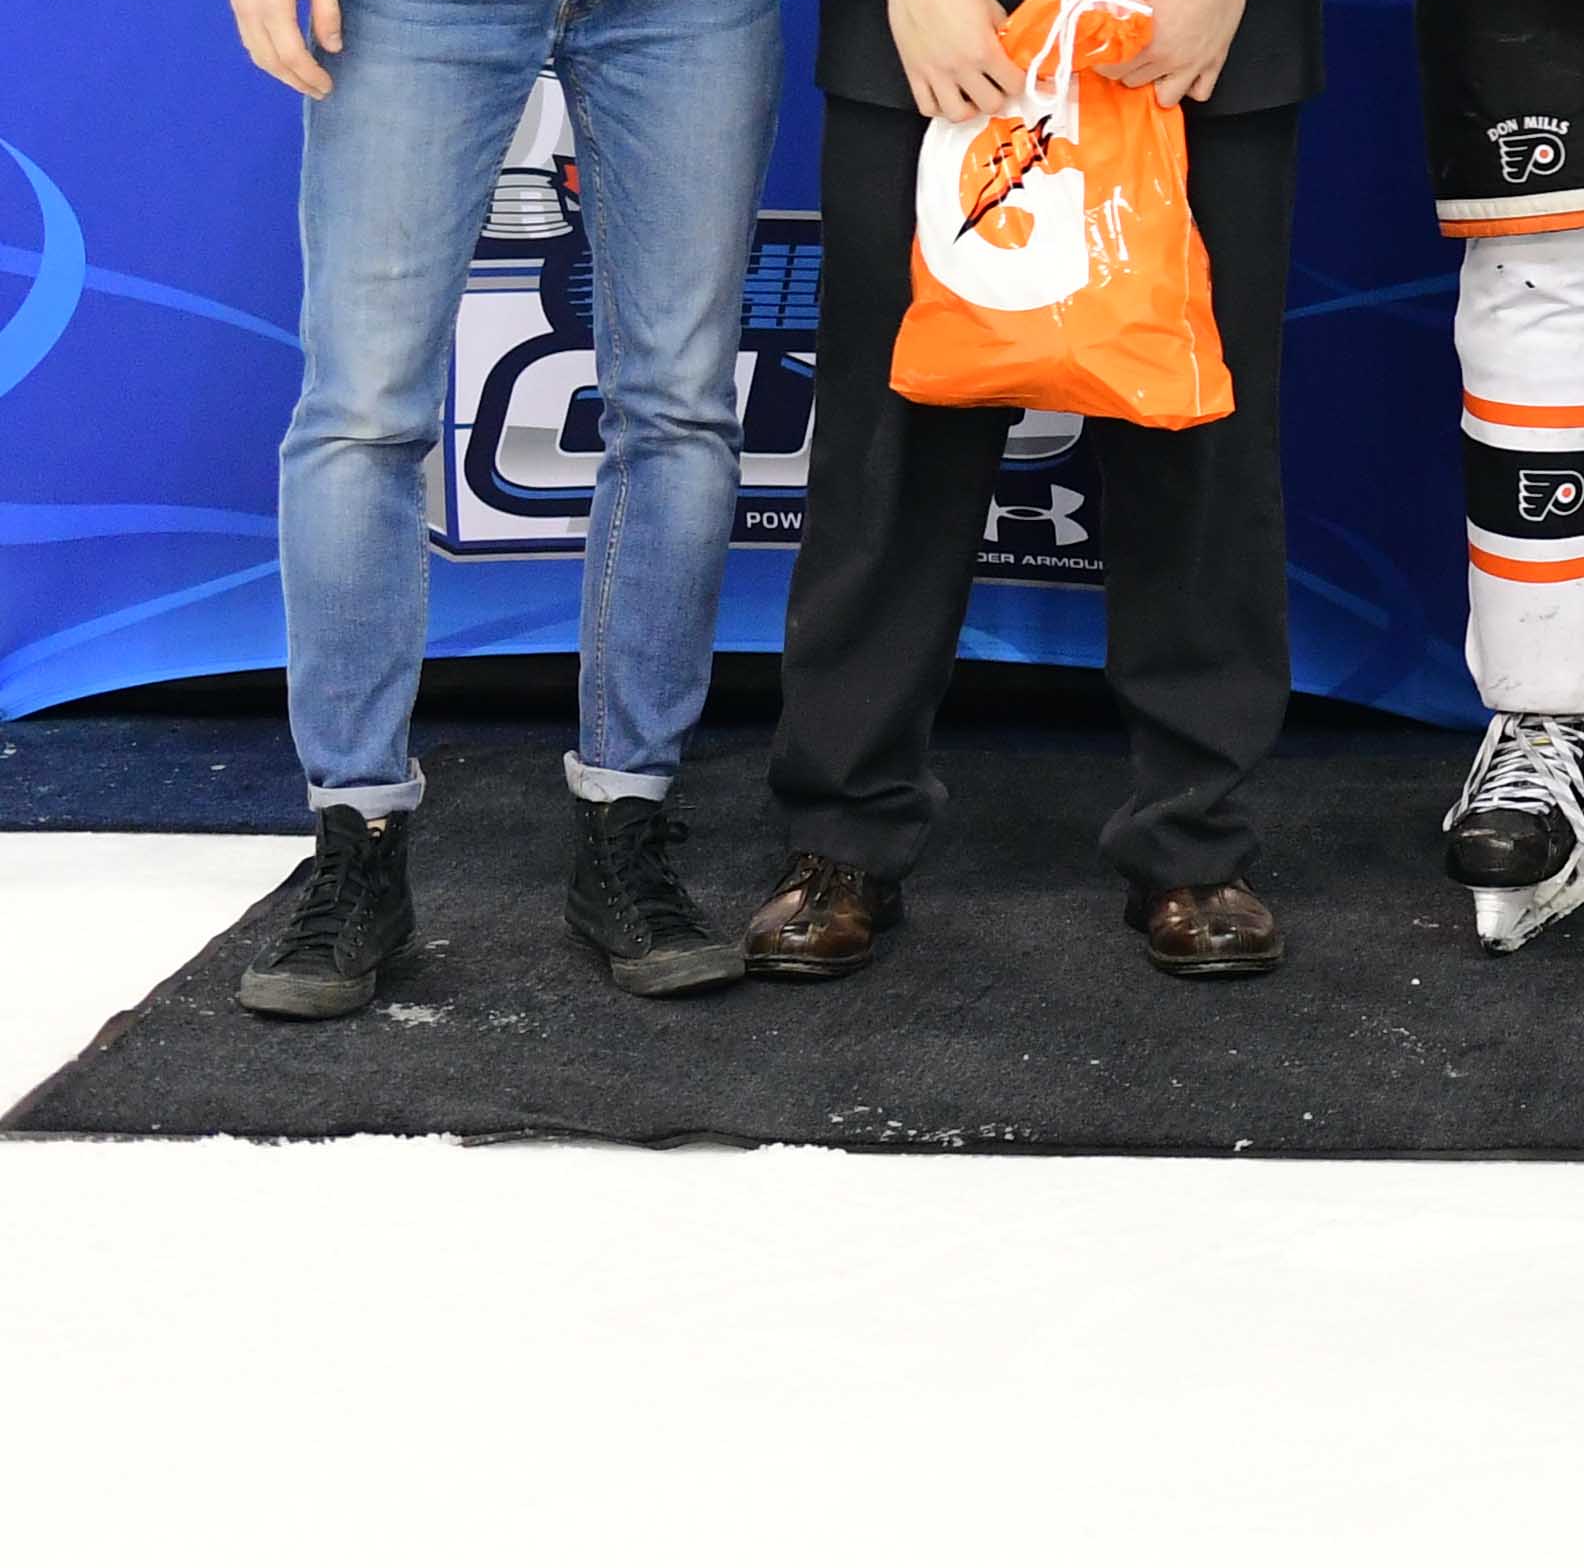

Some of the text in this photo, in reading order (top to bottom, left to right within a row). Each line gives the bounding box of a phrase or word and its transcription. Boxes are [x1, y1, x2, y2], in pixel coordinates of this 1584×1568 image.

[1487, 116, 1570, 141] DON MILLS
[1022, 554, 1104, 571] ARMOU
